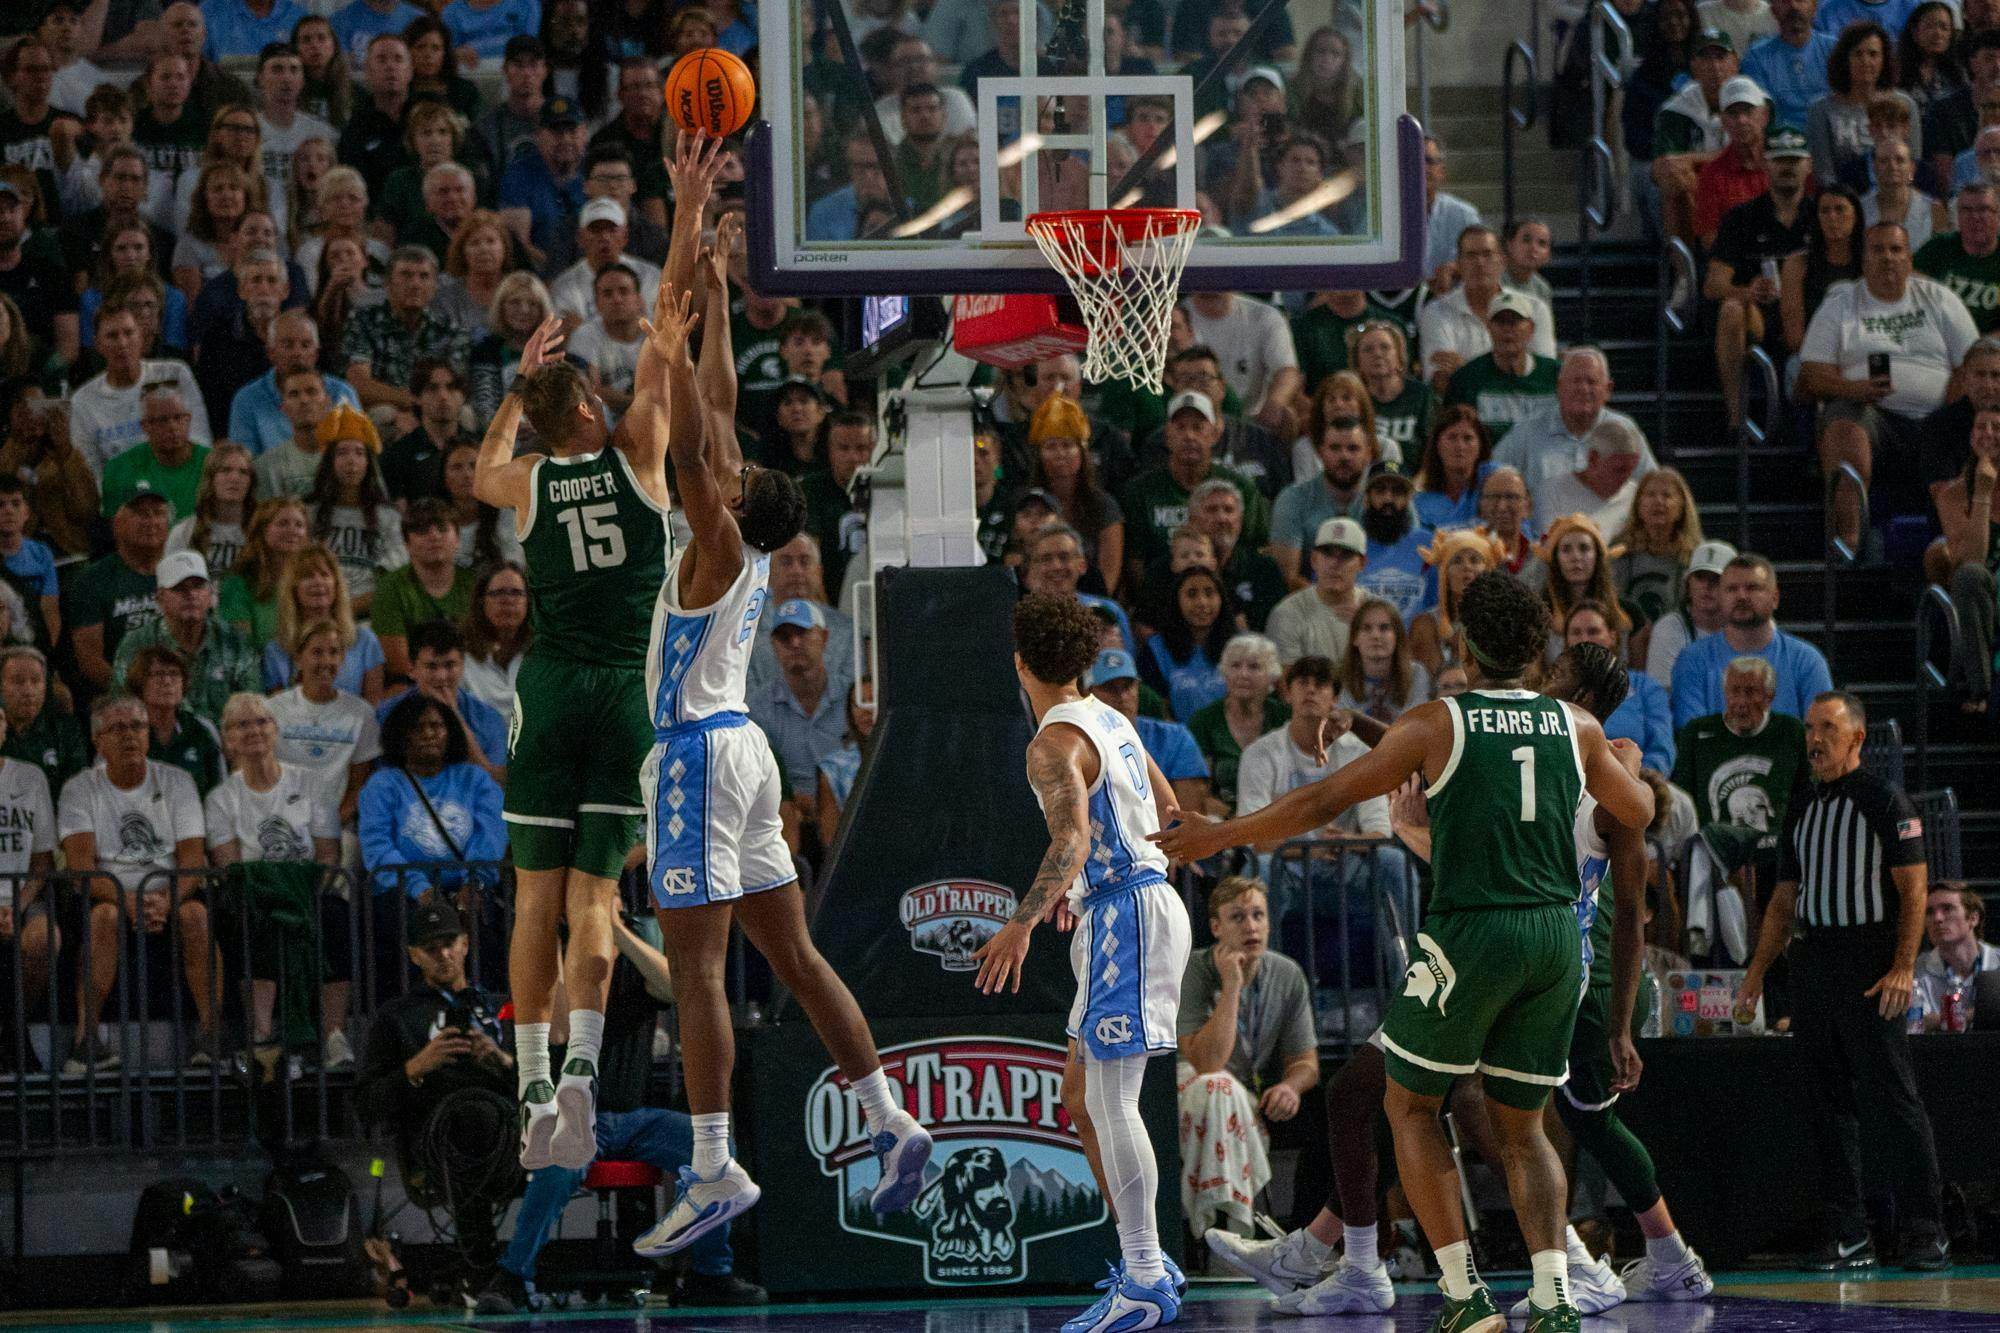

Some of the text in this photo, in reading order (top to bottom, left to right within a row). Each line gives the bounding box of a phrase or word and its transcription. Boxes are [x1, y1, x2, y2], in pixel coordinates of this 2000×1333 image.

[706, 76, 726, 133] Wilson
[549, 471, 619, 503] COOPER
[556, 501, 627, 572] 15
[737, 587, 767, 645] 2
[1466, 708, 1568, 736] FEARS JR.
[1118, 742, 1148, 801] 0
[1511, 745, 1536, 822] 1
[902, 885, 1019, 924] OLD TRAPPER
[811, 1052, 1080, 1156] OL TRAPP
[937, 1264, 1014, 1277] SINCE 1969
